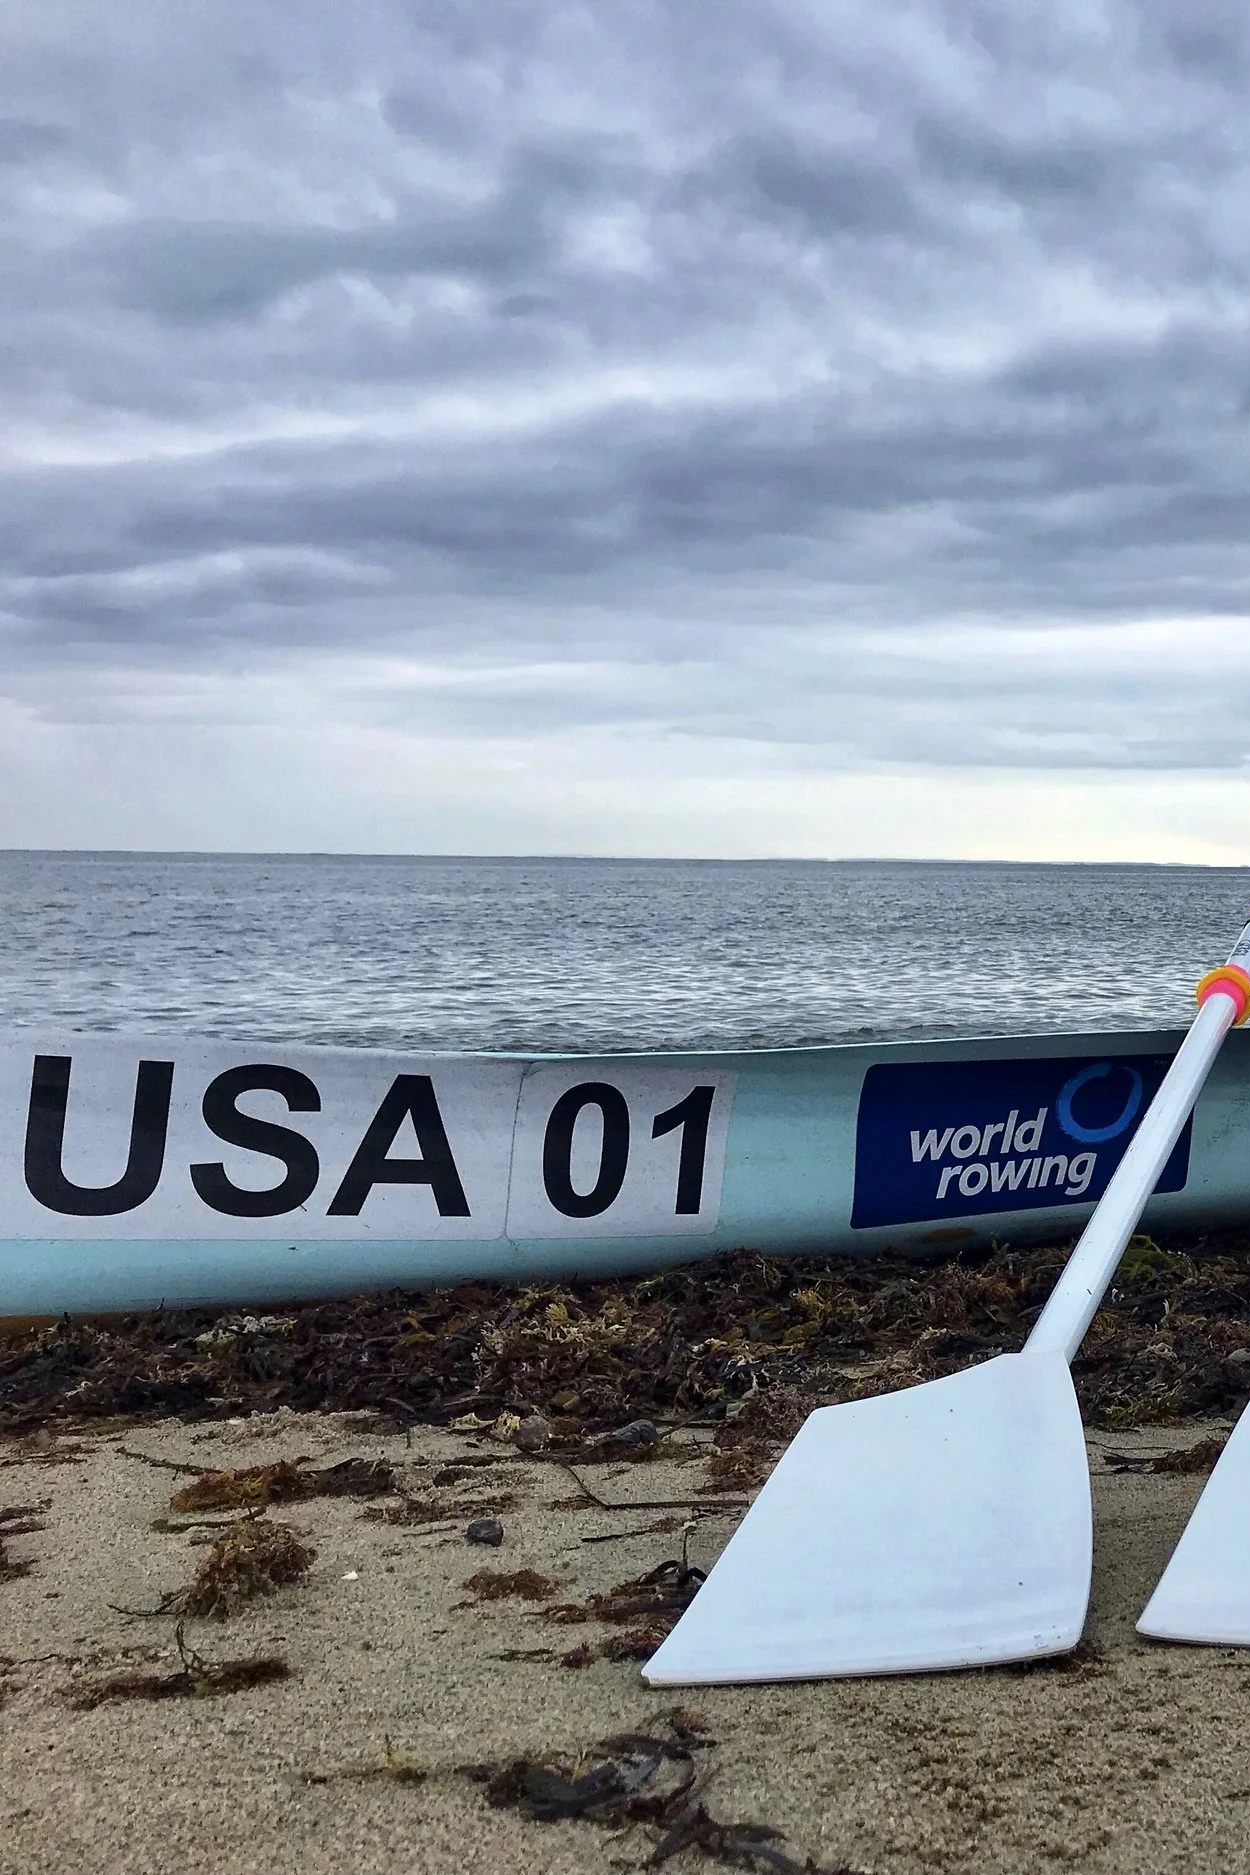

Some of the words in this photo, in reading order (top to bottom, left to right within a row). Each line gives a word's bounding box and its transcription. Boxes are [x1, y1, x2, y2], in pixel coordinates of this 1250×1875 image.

[24, 1054, 472, 1218] USA
[542, 1081, 716, 1219] 01
[909, 1107, 1049, 1163] world
[935, 1152, 1098, 1200] rowing
